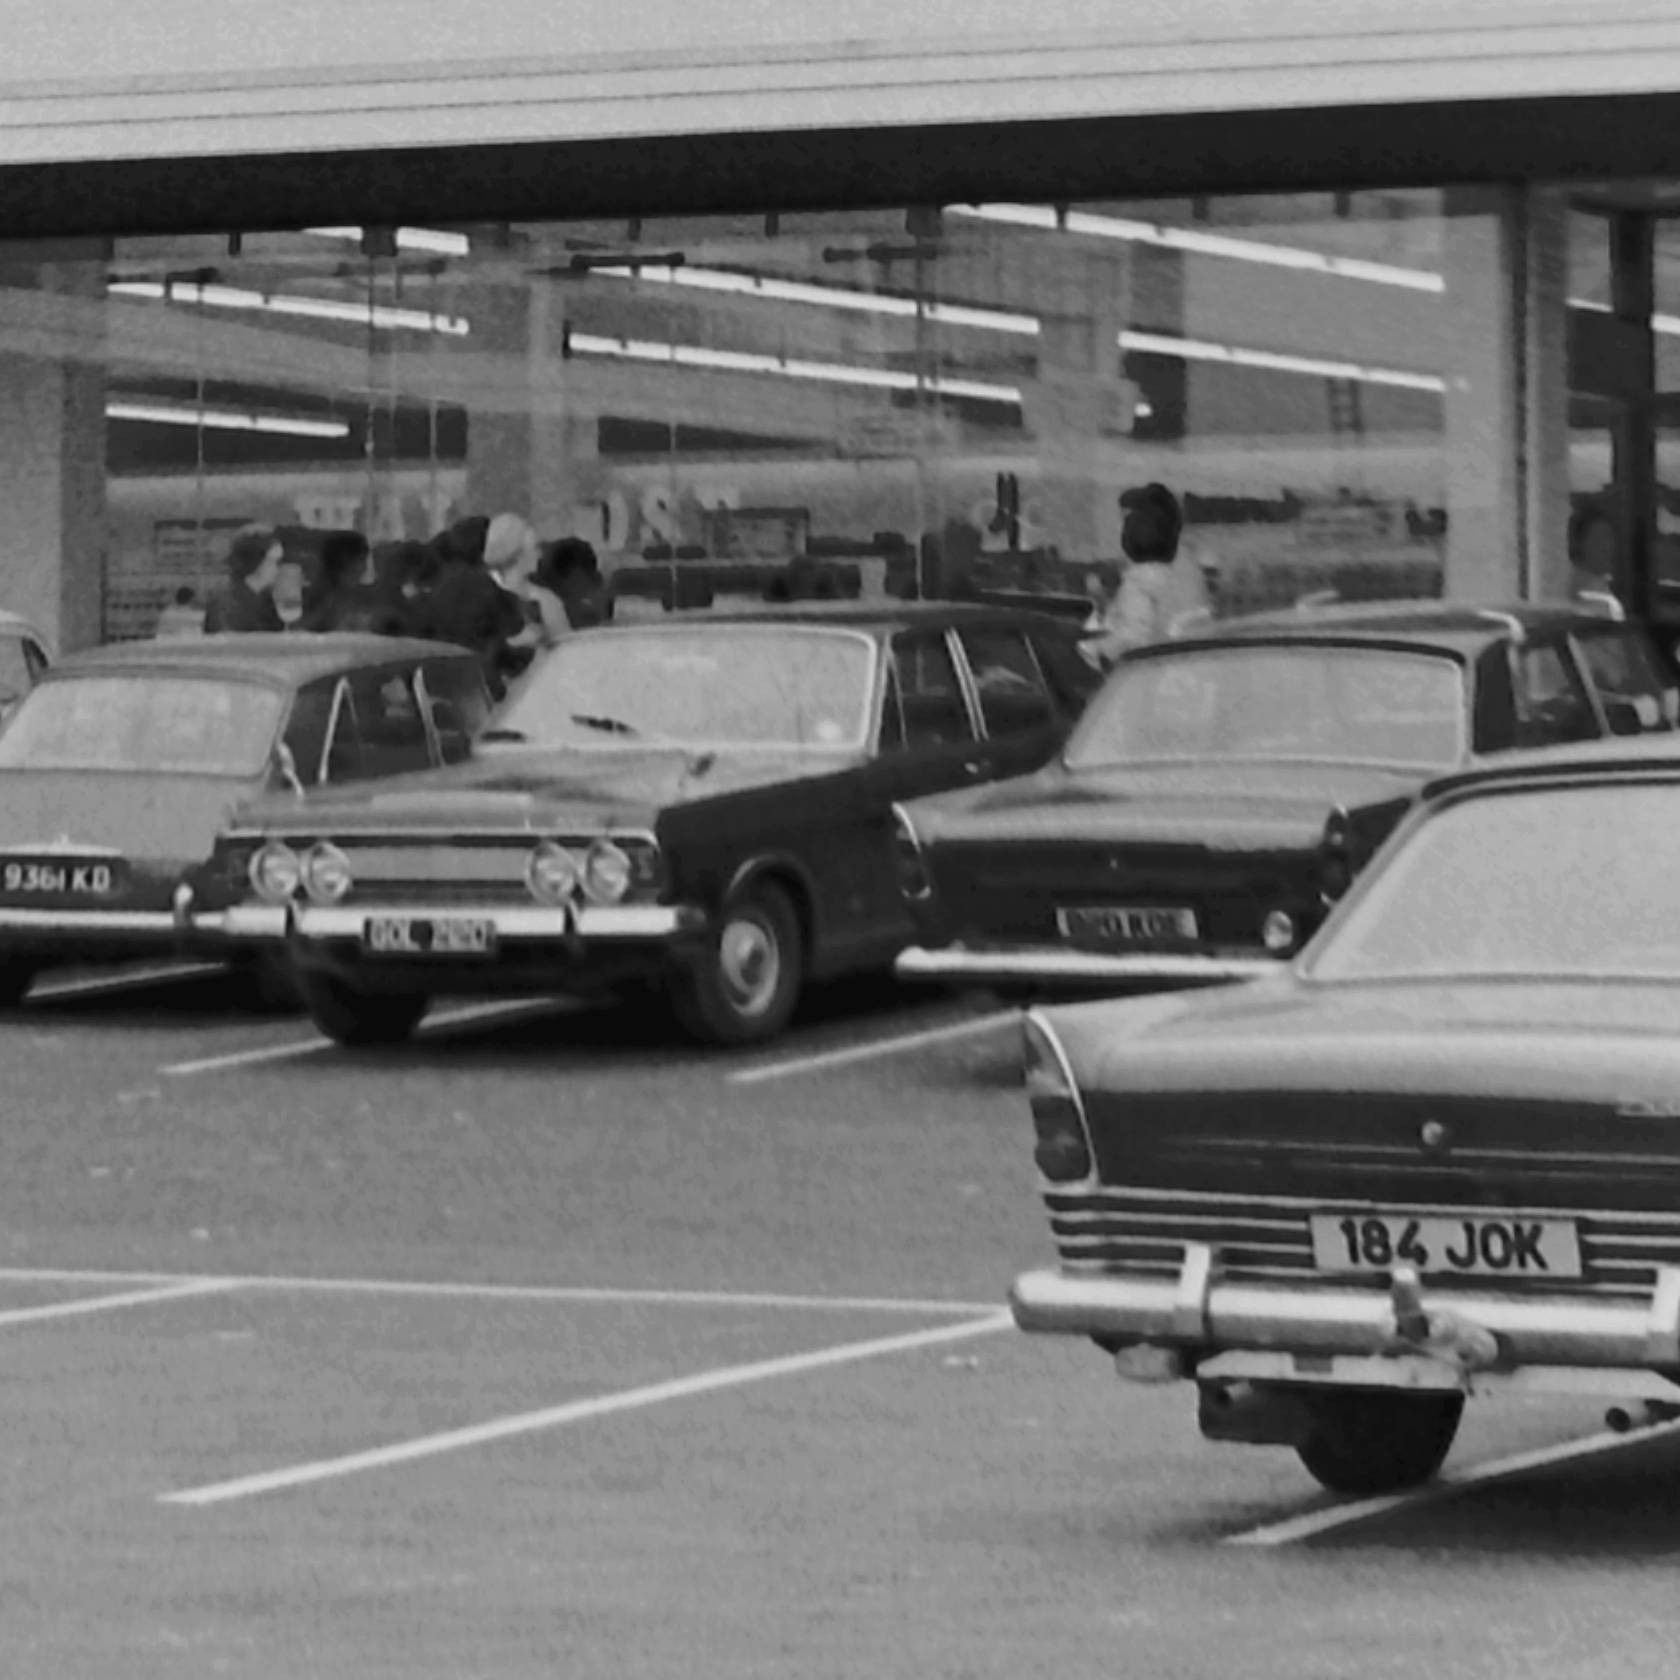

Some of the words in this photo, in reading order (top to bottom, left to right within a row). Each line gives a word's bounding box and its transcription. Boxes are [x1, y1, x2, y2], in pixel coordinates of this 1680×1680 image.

[4, 862, 67, 892] 9361
[1340, 1218, 1429, 1267] 184
[1445, 1220, 1548, 1270] JOK
